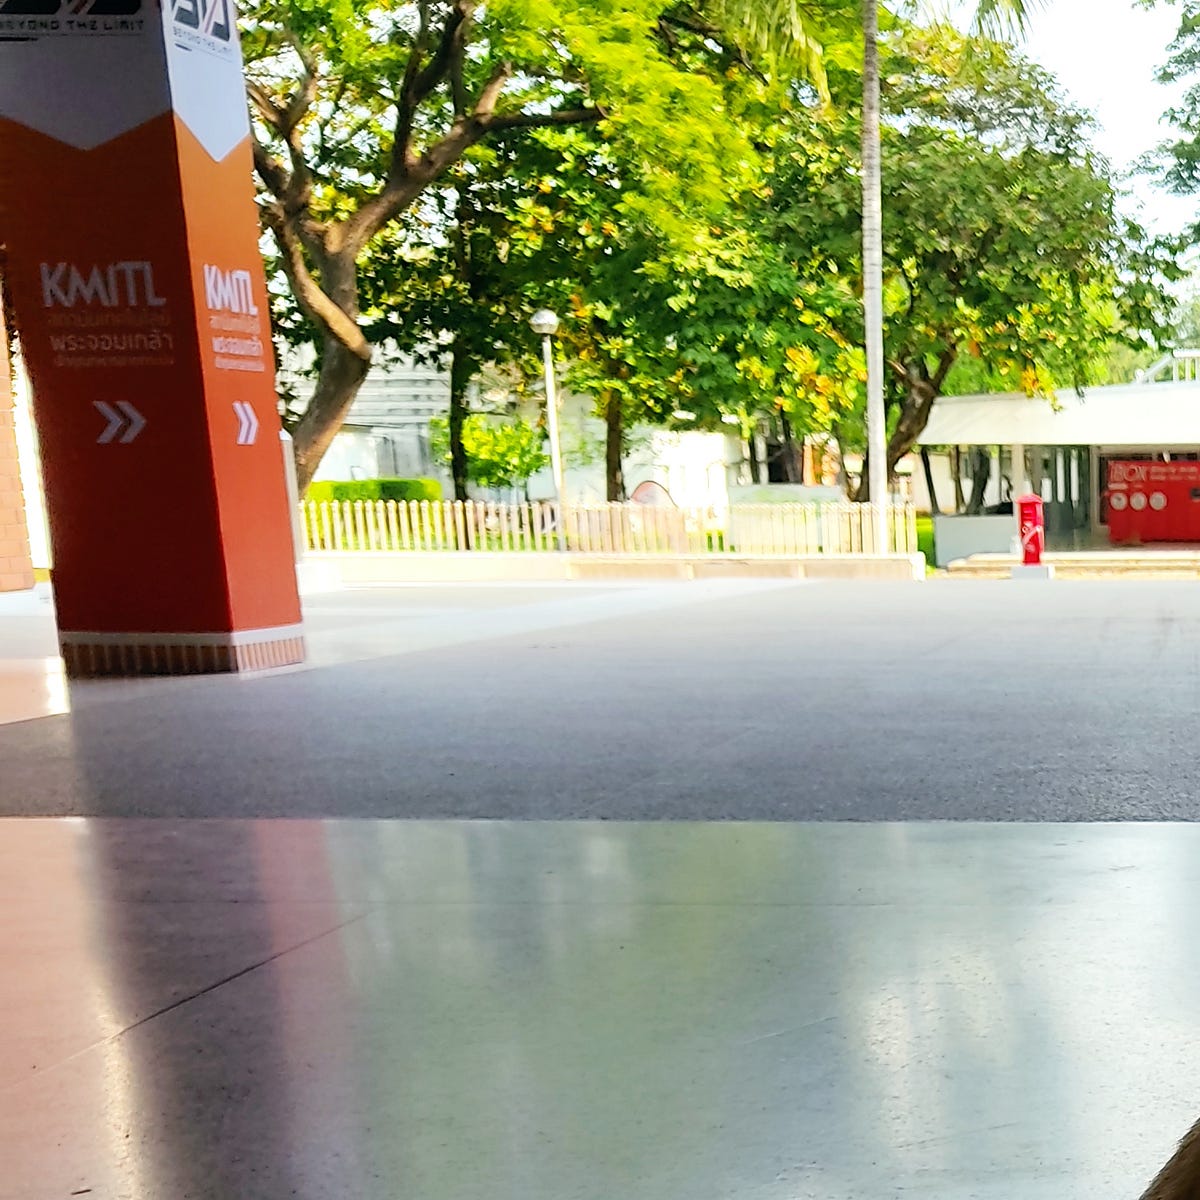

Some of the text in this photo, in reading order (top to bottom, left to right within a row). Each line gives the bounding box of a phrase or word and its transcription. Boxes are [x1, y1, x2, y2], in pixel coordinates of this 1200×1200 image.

[66, 20, 98, 31] THE
[103, 20, 144, 31] LIMIT
[39, 261, 167, 307] KMITL
[203, 263, 258, 316] KMITL
[48, 329, 174, 351] พระจอมเกล้า
